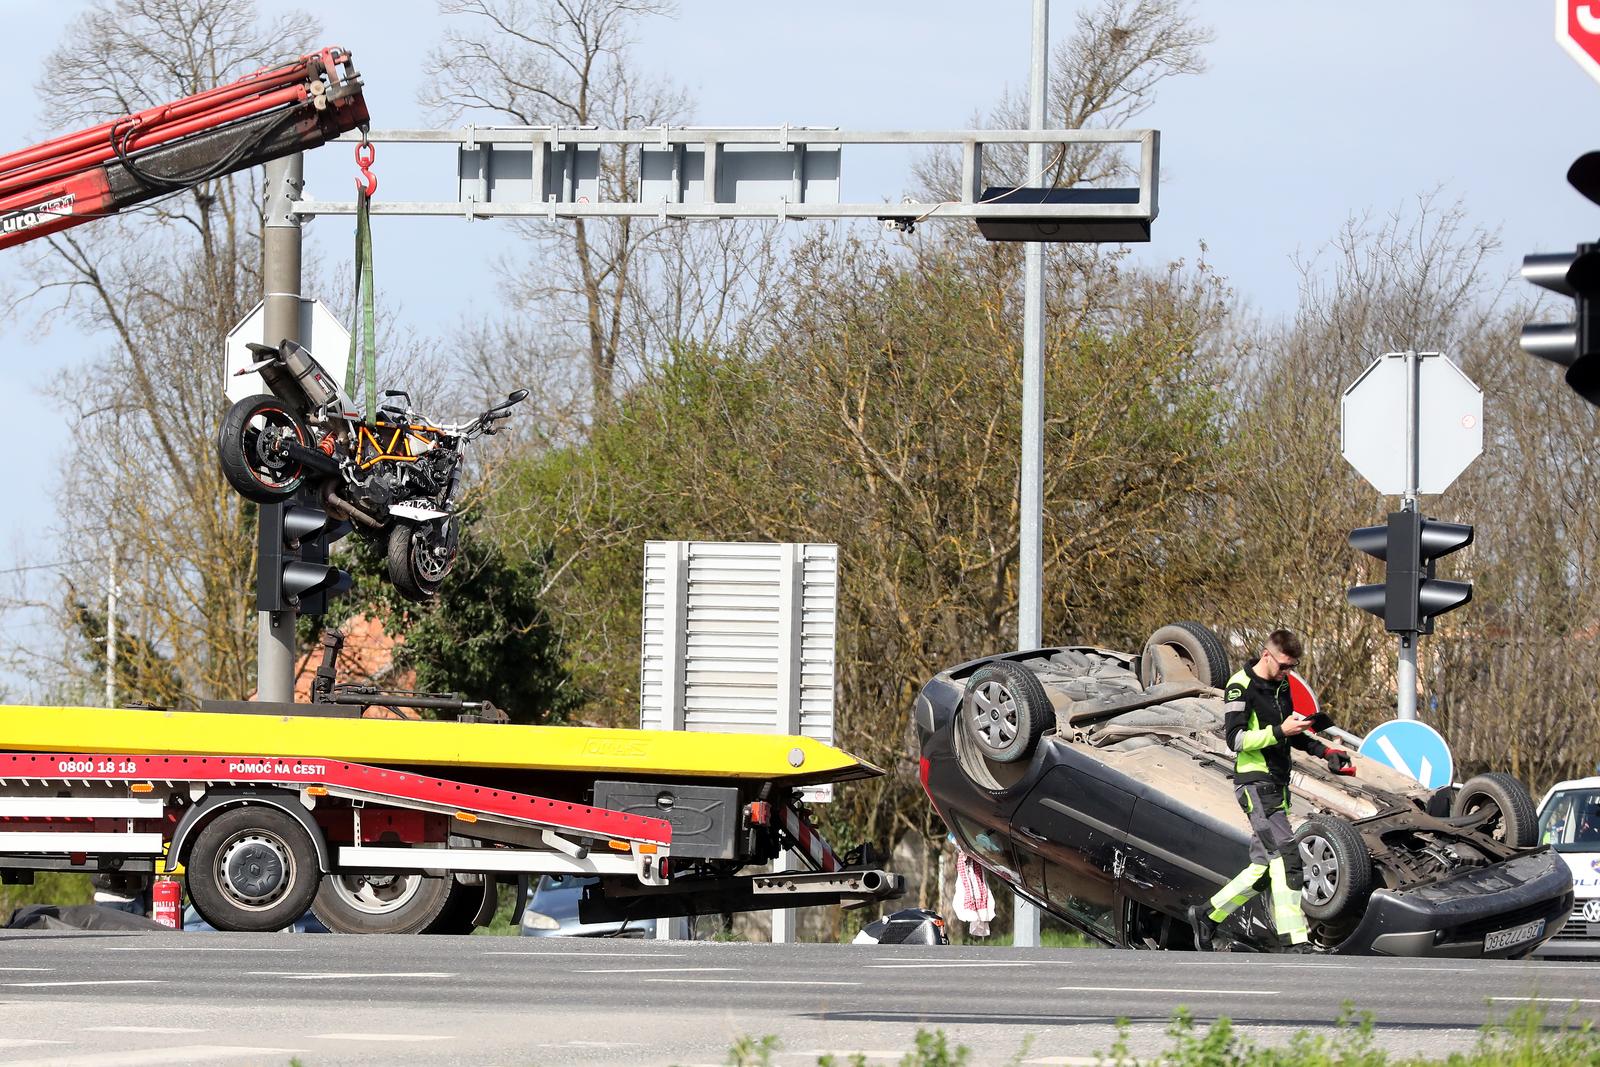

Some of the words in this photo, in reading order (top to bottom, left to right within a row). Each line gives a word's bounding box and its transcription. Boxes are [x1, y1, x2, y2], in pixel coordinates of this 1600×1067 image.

[0, 212, 37, 232] uro
[58, 761, 94, 773] 0800
[97, 761, 115, 773] 18
[118, 761, 137, 774] 18
[229, 761, 272, 774] POMOĆ
[274, 764, 291, 774] NA
[293, 765, 325, 775] CESTI
